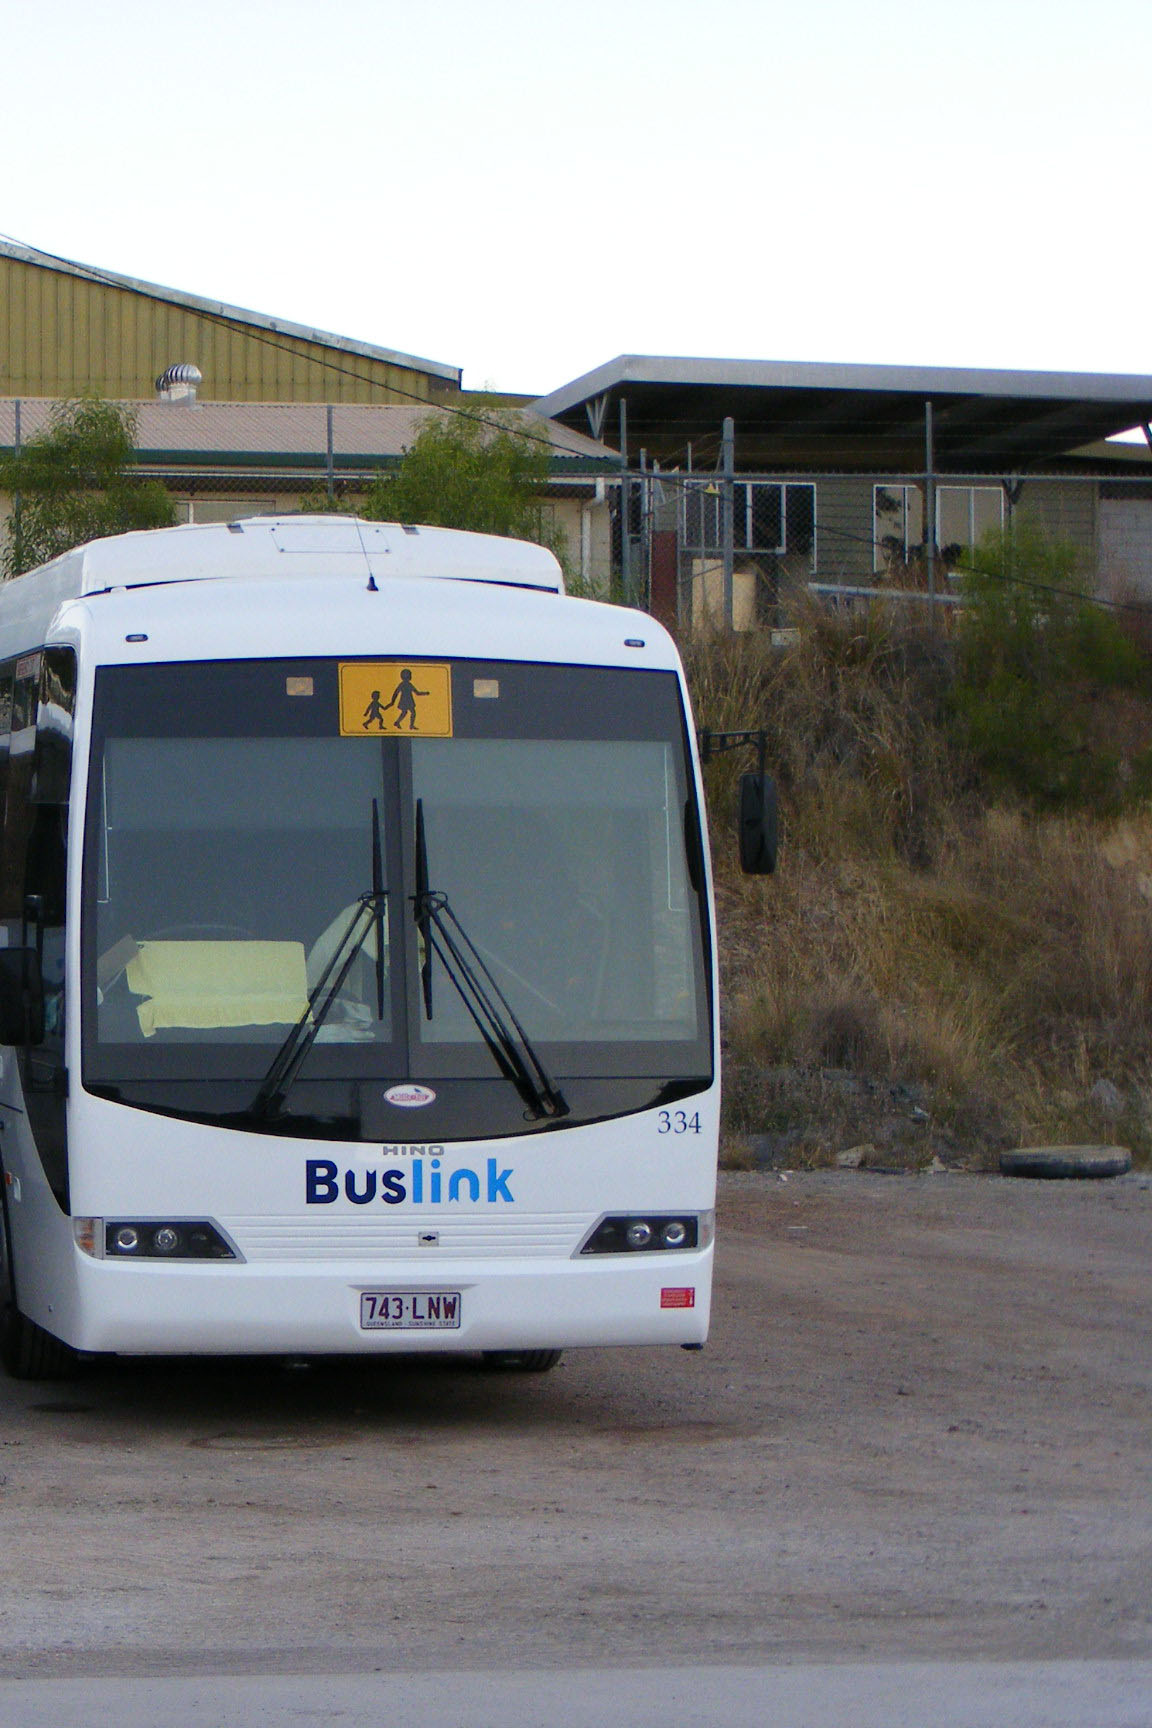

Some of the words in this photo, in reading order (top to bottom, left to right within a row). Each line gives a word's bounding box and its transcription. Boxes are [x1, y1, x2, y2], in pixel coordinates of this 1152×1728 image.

[658, 1111, 702, 1134] 334
[383, 1145, 445, 1156] HINO
[306, 1158, 515, 1205] Buslink
